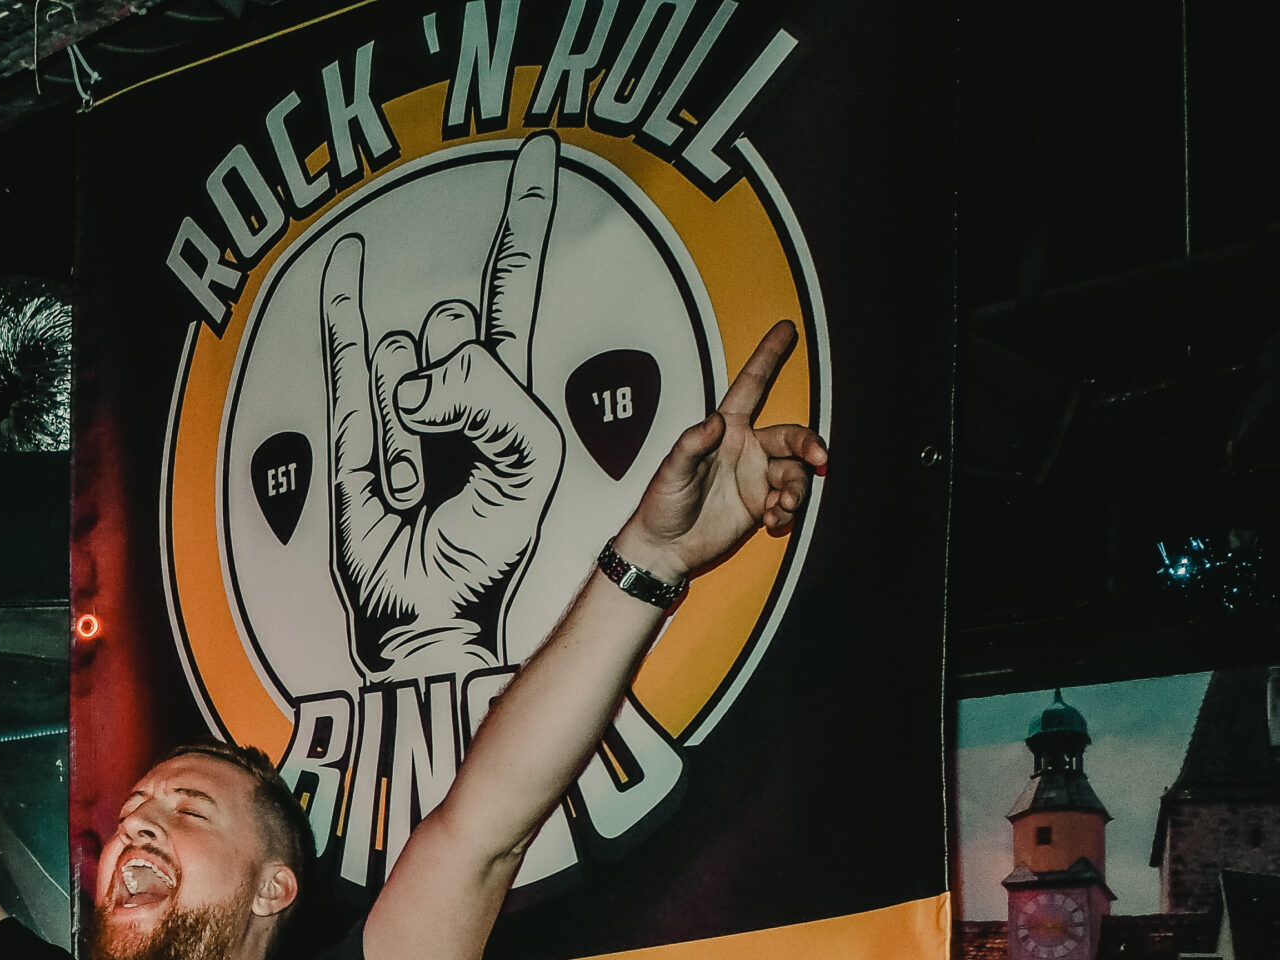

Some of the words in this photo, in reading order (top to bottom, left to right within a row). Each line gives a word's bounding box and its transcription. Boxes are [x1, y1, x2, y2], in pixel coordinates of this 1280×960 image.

[165, 40, 396, 324] ROCK
[529, 0, 799, 185] ROLL
[591, 386, 633, 422] '18
[267, 462, 297, 497] EST
